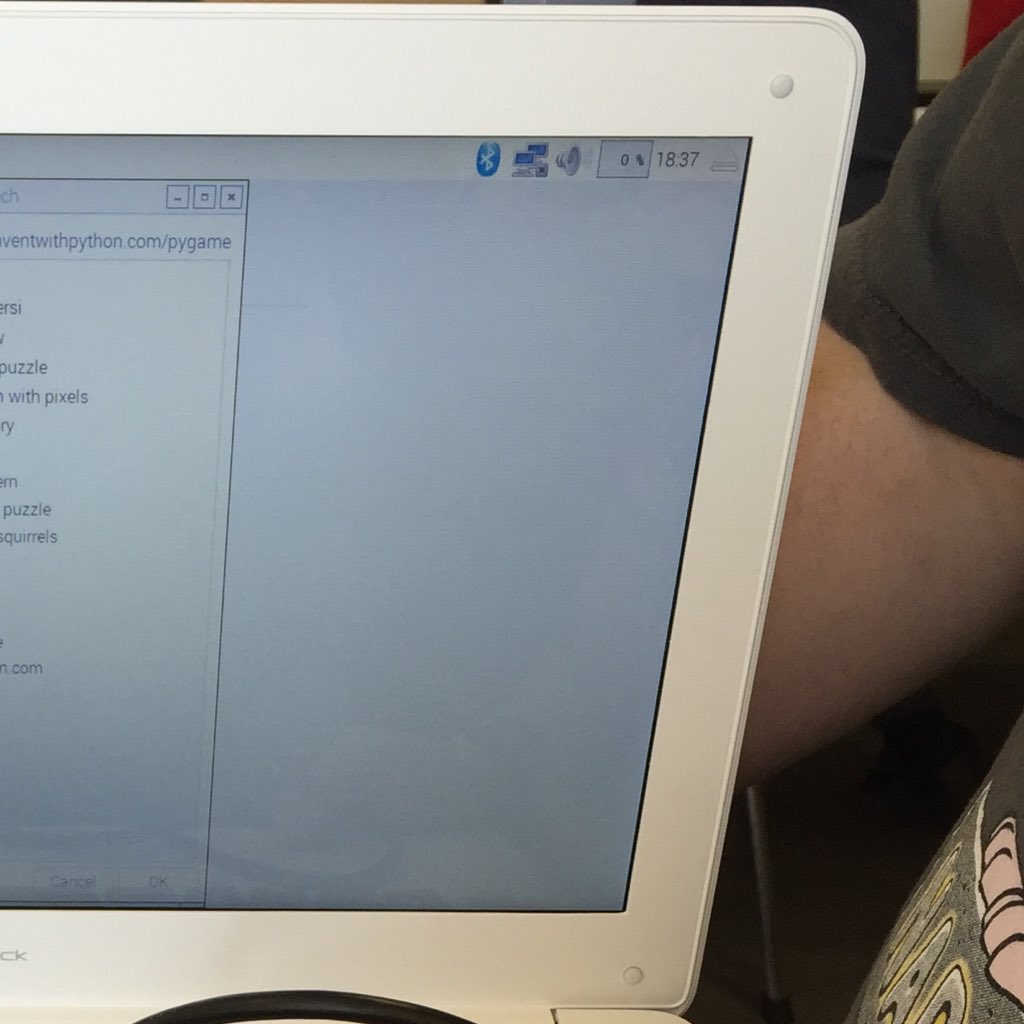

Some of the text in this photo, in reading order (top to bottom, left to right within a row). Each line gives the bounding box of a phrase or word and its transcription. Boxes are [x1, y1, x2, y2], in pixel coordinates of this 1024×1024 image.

[657, 151, 700, 168] 18:37
[9, 388, 41, 405] with
[44, 389, 89, 408] pixels
[3, 503, 52, 520] puzzle
[50, 874, 97, 888] Cancel
